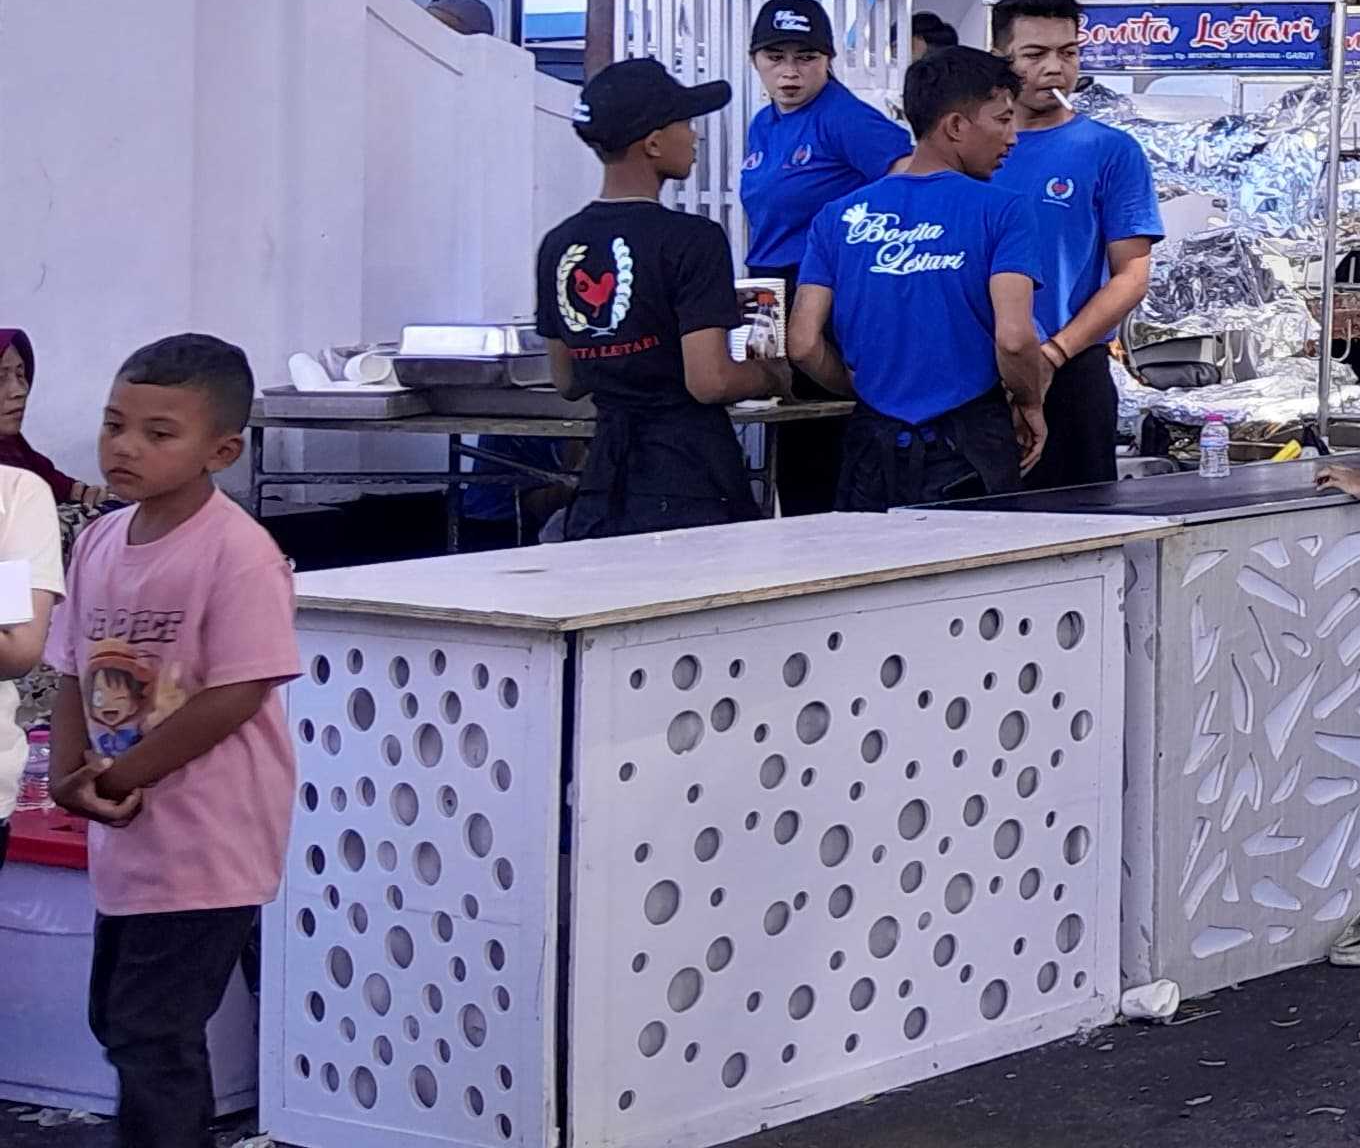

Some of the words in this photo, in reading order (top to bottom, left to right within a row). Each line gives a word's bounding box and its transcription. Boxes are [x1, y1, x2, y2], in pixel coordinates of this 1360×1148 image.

[1190, 10, 1320, 50] Lestari
[846, 212, 944, 244] Bonita
[870, 241, 965, 275] Lestari
